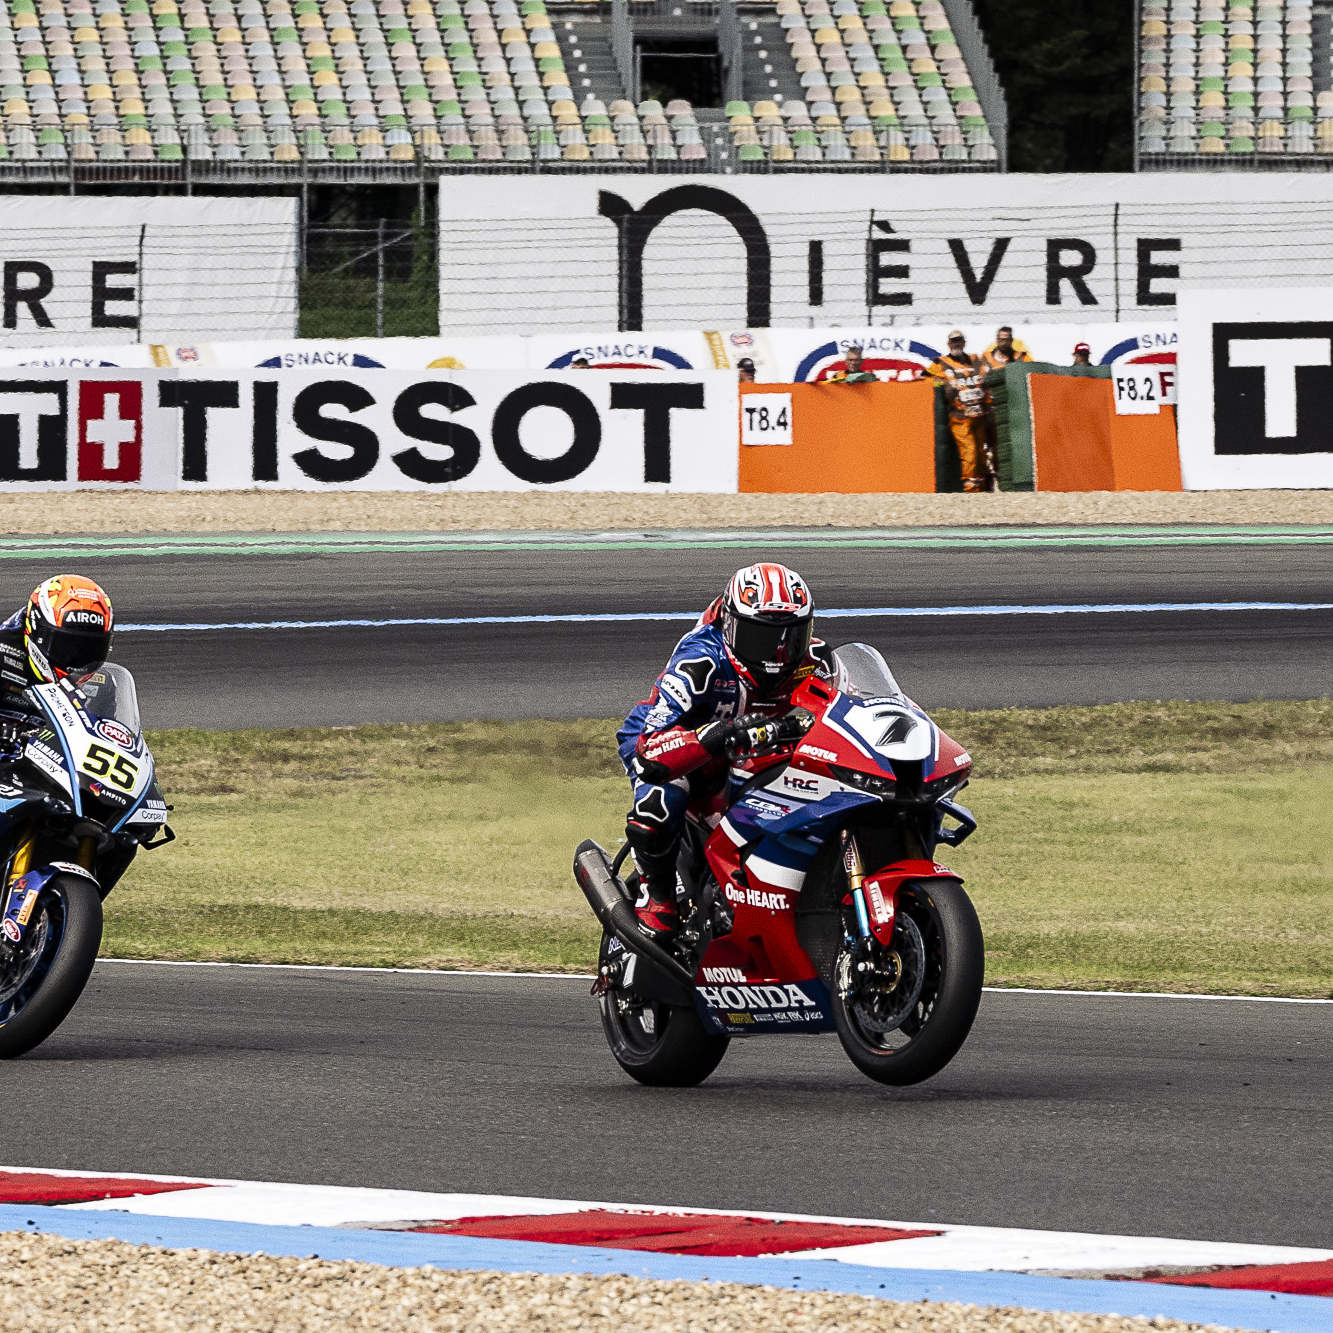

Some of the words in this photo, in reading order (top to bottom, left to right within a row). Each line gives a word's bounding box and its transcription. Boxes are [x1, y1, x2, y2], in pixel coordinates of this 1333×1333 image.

[284, 351, 349, 367] SNACK
[1116, 377, 1156, 401] F8.2
[744, 406, 789, 432] T8.4
[158, 379, 705, 485] TISSOT
[66, 611, 104, 626] AIROH
[862, 696, 907, 708] HONDA
[104, 725, 131, 745] PATA
[872, 710, 919, 747] 7
[33, 739, 65, 764] YAMAHA
[798, 744, 839, 763] MOTUL
[82, 742, 140, 792] 55
[783, 775, 819, 792] HRC
[101, 789, 127, 806] AMPITO
[725, 882, 746, 904] One
[702, 967, 747, 983] MOTUL
[695, 983, 817, 1010] HONDA
